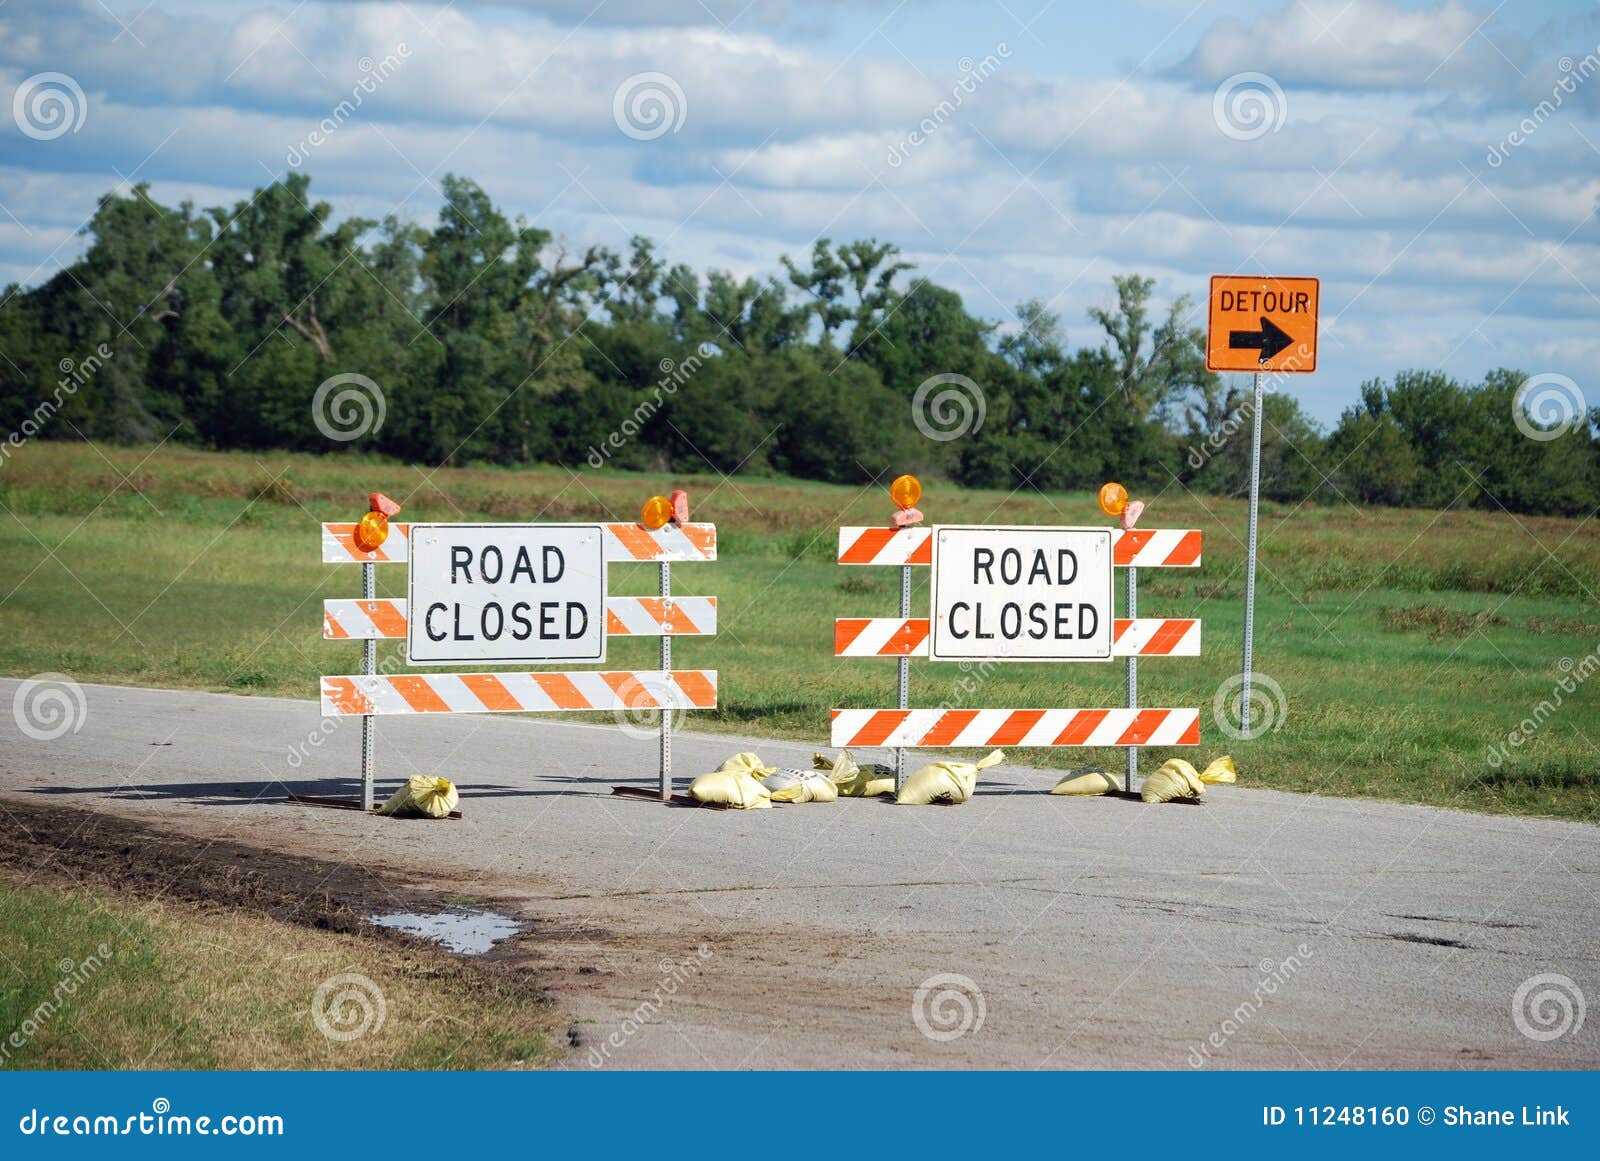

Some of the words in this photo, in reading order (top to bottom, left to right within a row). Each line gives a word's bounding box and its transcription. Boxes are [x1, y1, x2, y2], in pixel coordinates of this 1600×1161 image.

[1220, 291, 1309, 313] DETOUR
[451, 545, 565, 584] ROAD
[973, 547, 1078, 585] ROAD
[425, 601, 588, 641] CLOSED
[948, 601, 1098, 640] CLOSED
